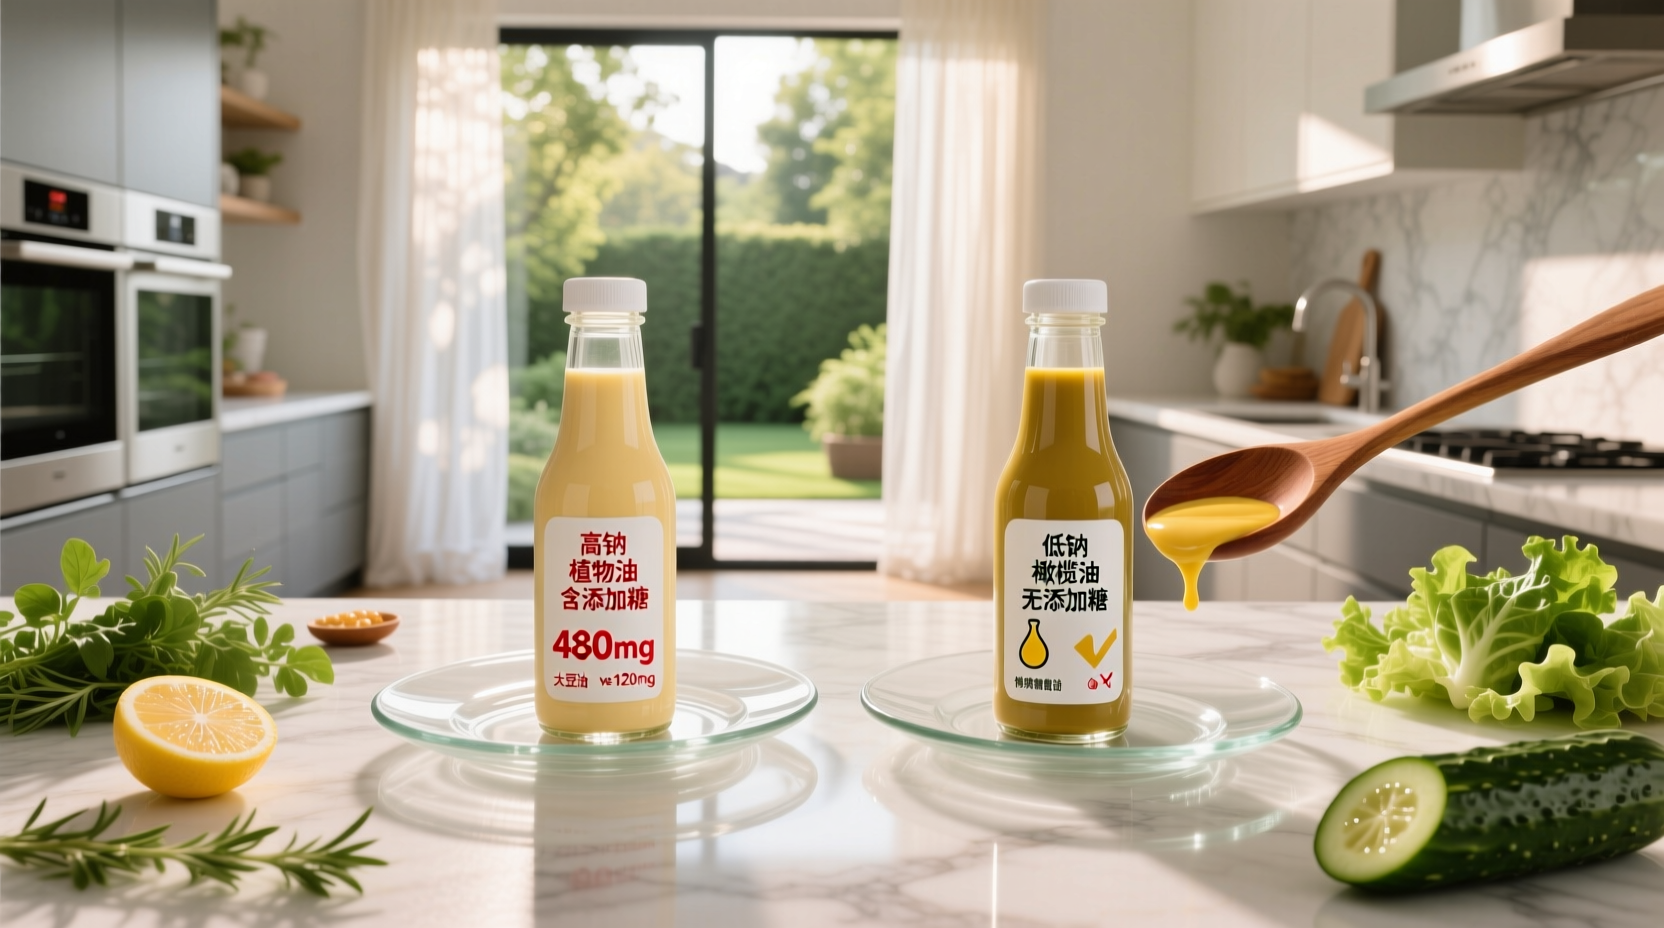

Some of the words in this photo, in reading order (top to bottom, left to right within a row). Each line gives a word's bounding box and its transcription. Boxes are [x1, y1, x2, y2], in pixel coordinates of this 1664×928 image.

[580, 531, 627, 556] 高钠
[1042, 533, 1088, 558] 低钠
[569, 558, 638, 583] 植物油
[1031, 559, 1100, 585] 橄榄油
[560, 586, 649, 611] 含添加糖
[1021, 587, 1109, 612] 无添加糖
[552, 629, 655, 665] 480mg
